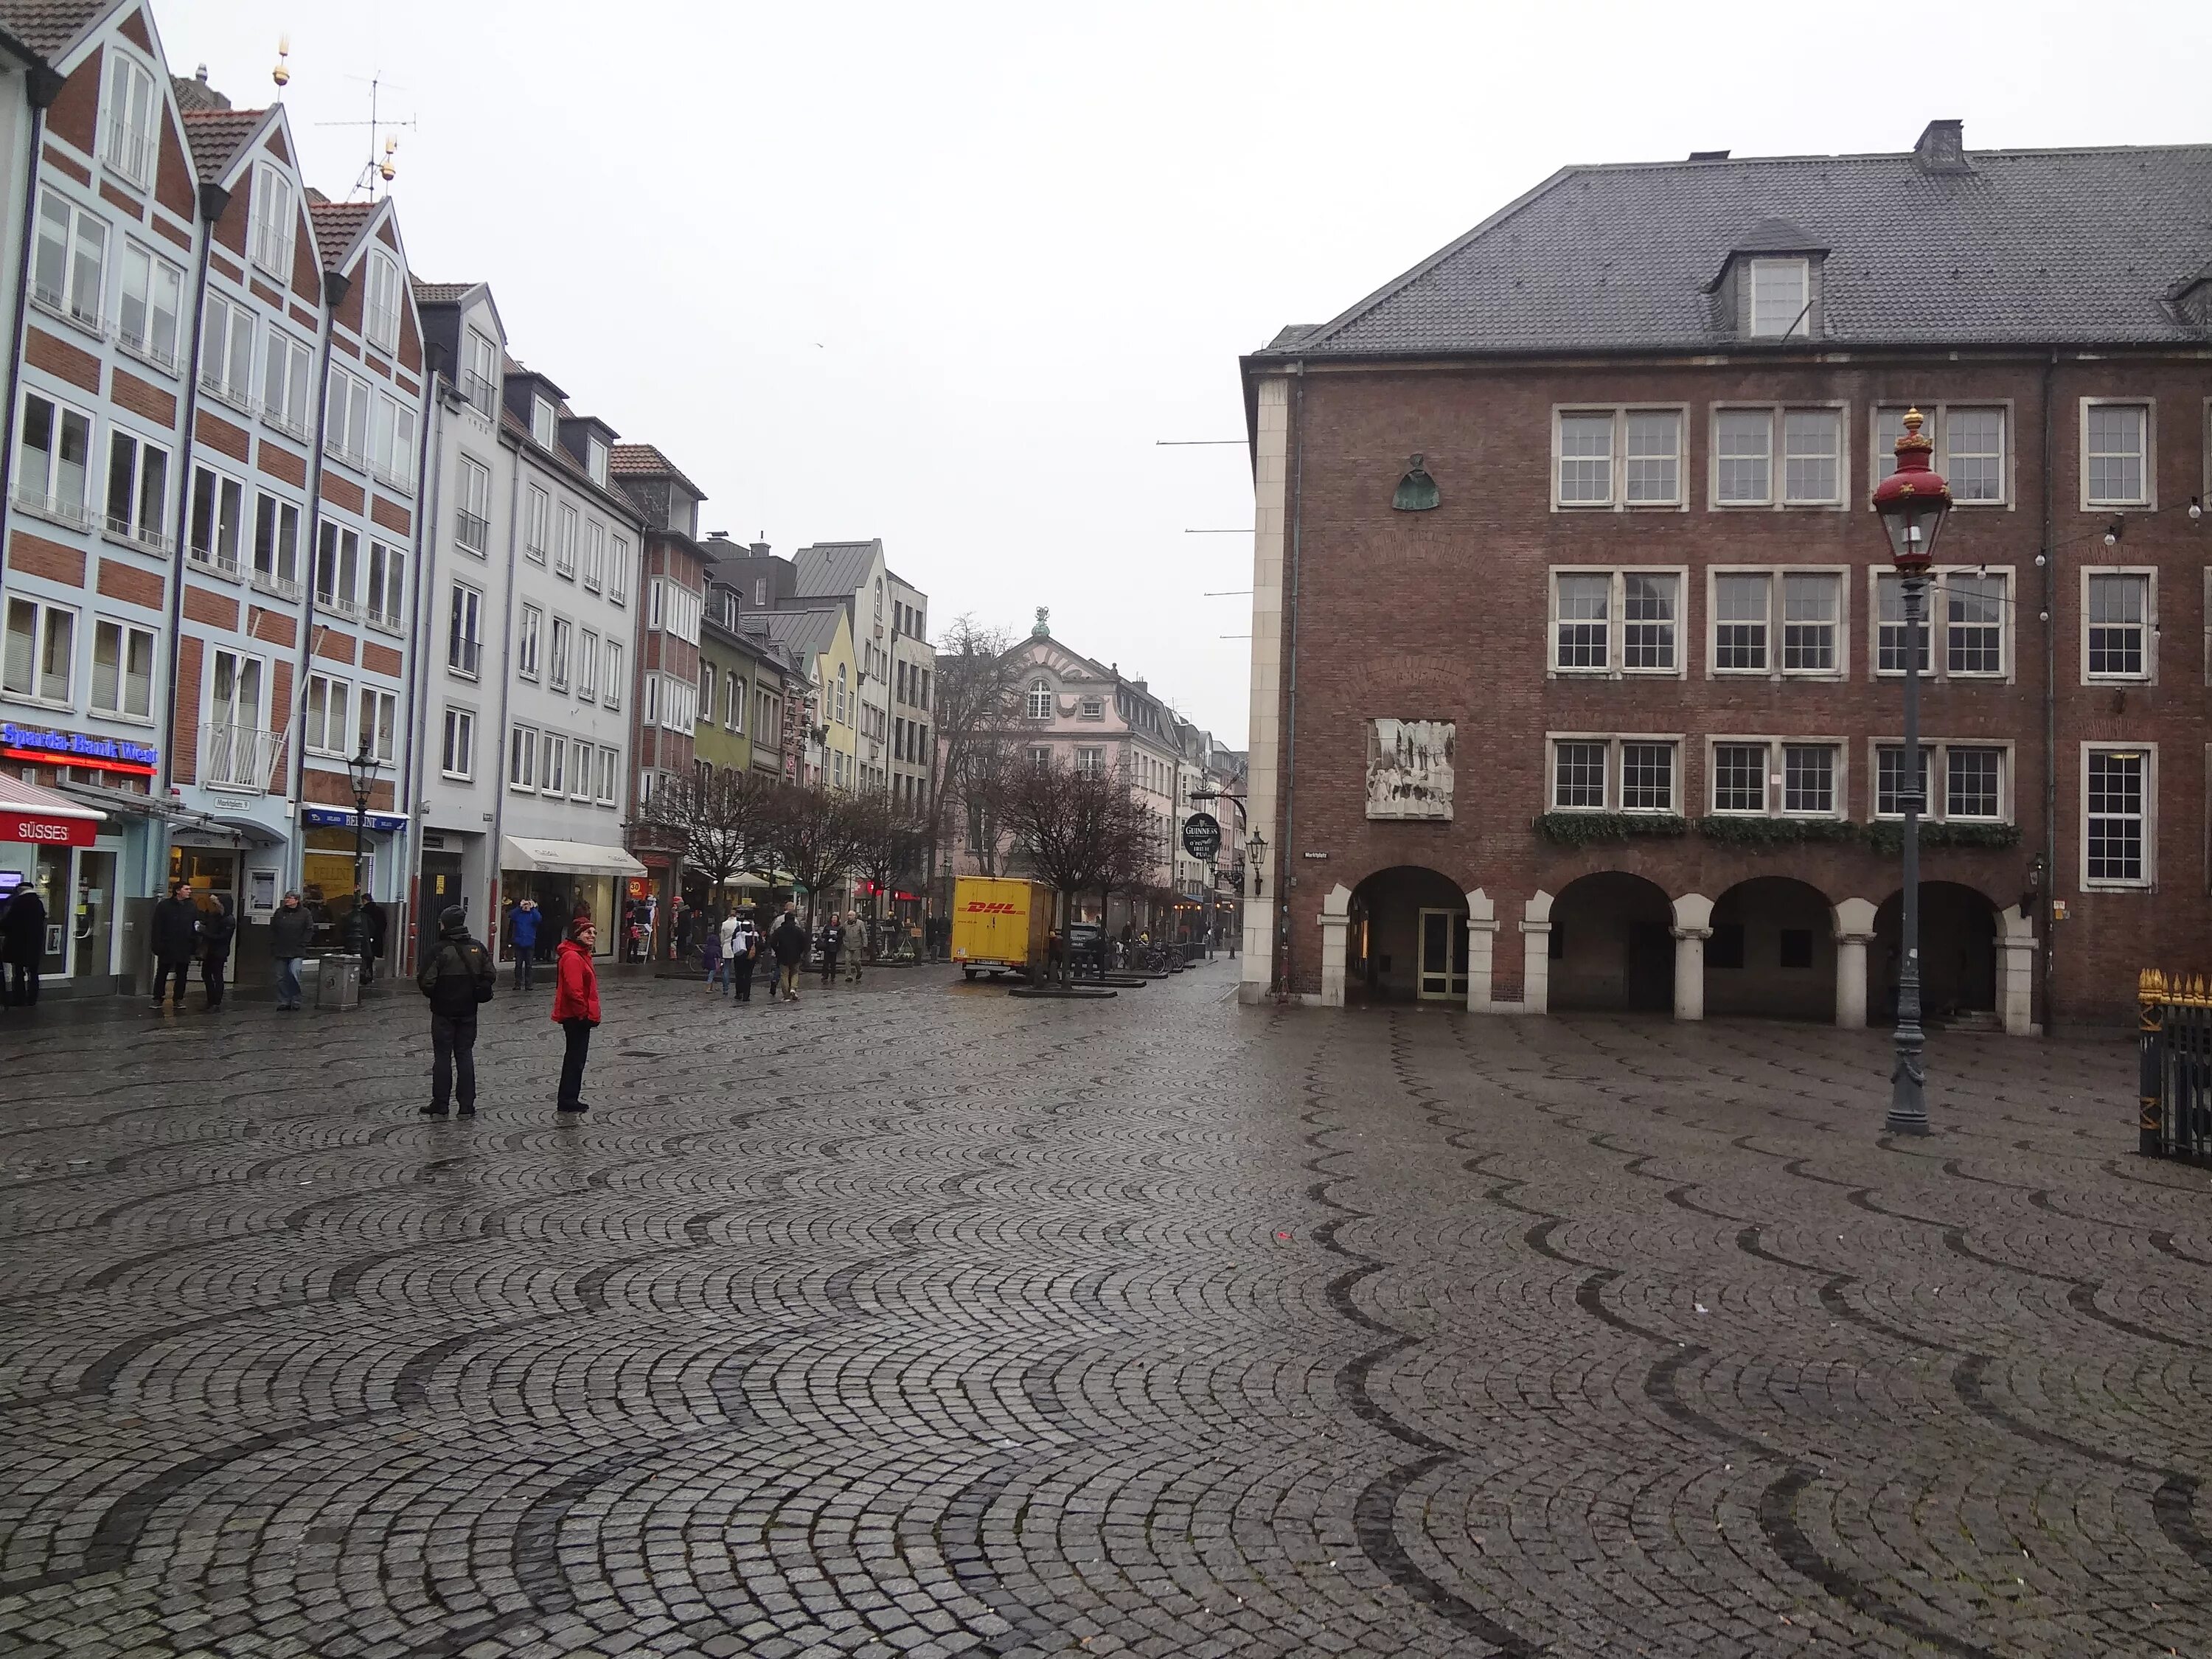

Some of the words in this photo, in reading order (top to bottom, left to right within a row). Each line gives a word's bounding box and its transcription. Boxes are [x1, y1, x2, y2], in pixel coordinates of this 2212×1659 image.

[3, 723, 118, 758] Sparda-Bank
[121, 742, 159, 764] West
[18, 821, 68, 841] SÜSSES
[1186, 826, 1218, 835] GUINNESS
[967, 901, 1017, 915] DHL
